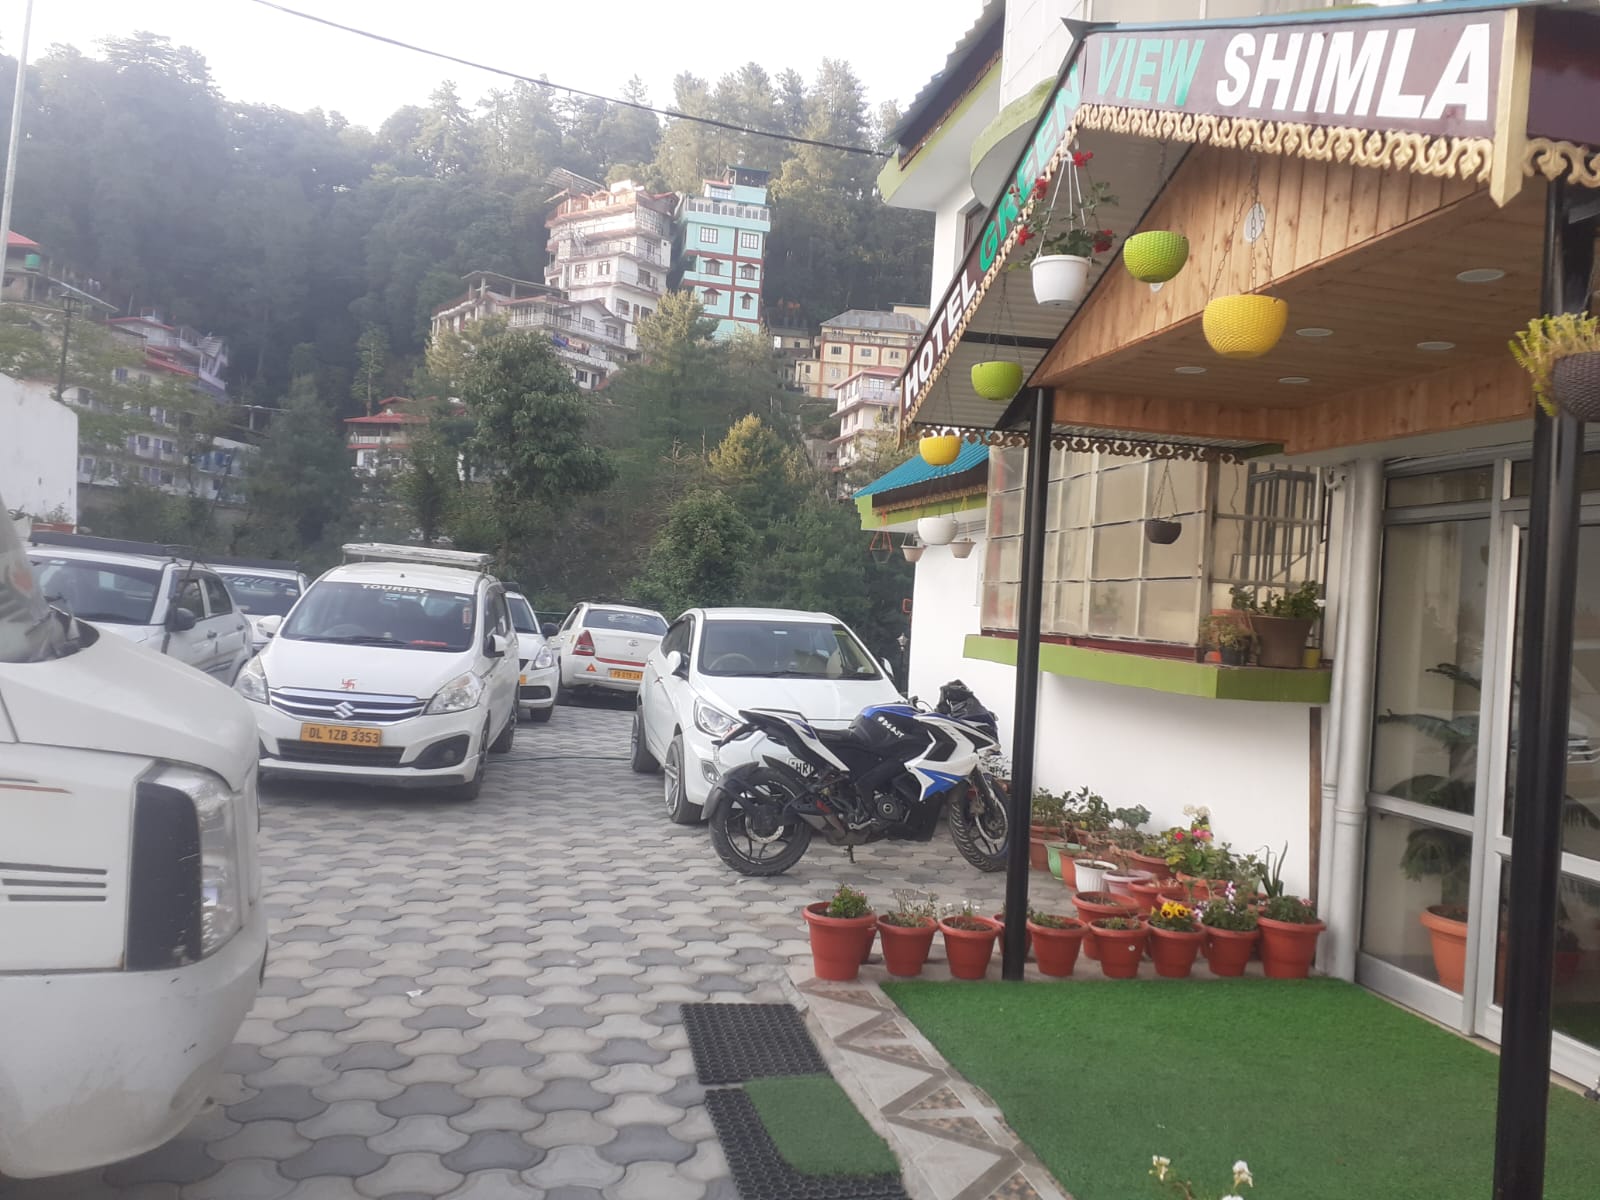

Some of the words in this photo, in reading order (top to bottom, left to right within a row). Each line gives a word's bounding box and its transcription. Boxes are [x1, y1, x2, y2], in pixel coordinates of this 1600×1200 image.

[1096, 36, 1206, 107] VIEW
[1216, 23, 1490, 121] SHIMLA
[904, 268, 977, 408] HOTEL
[980, 63, 1081, 272] GREEN
[361, 583, 429, 594] TOURIST
[309, 727, 322, 739] DL
[351, 731, 379, 744] 3353
